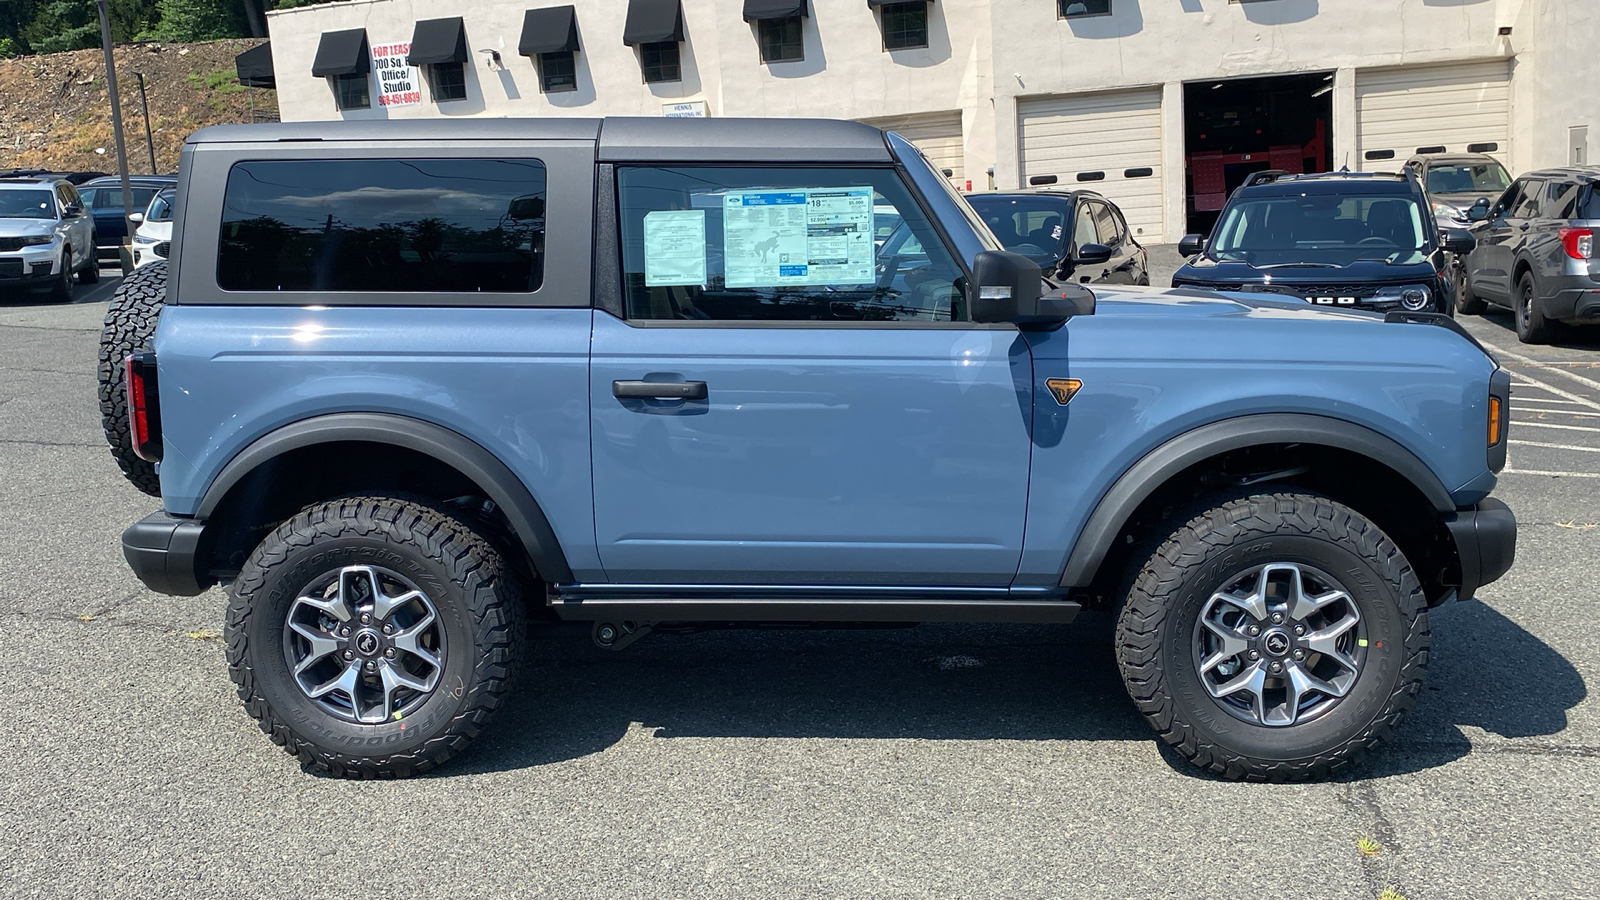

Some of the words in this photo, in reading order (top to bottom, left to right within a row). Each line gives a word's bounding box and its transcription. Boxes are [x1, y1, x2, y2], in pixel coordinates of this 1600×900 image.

[373, 46, 388, 57] FOR
[390, 57, 404, 68] Sq.
[382, 68, 409, 81] Office/
[383, 81, 411, 93] Studio
